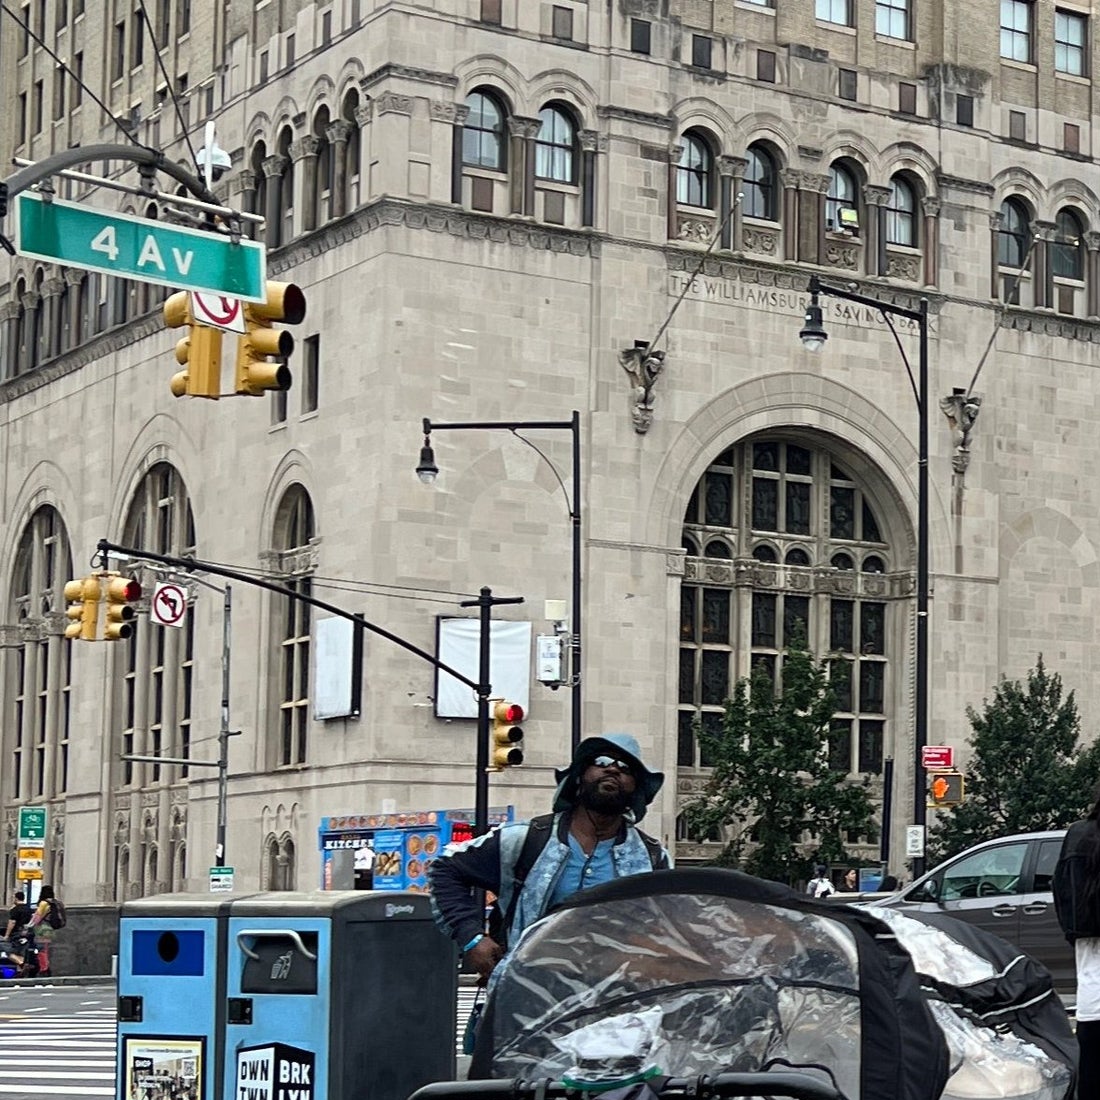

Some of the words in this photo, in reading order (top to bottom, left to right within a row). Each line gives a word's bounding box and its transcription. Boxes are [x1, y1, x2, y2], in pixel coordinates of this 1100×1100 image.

[90, 225, 120, 261] 4
[136, 234, 194, 275] Av
[670, 275, 699, 294] THE
[704, 279, 829, 317] WILLIAMSBURH
[240, 1058, 269, 1082] DWN
[279, 1059, 311, 1085] BRK
